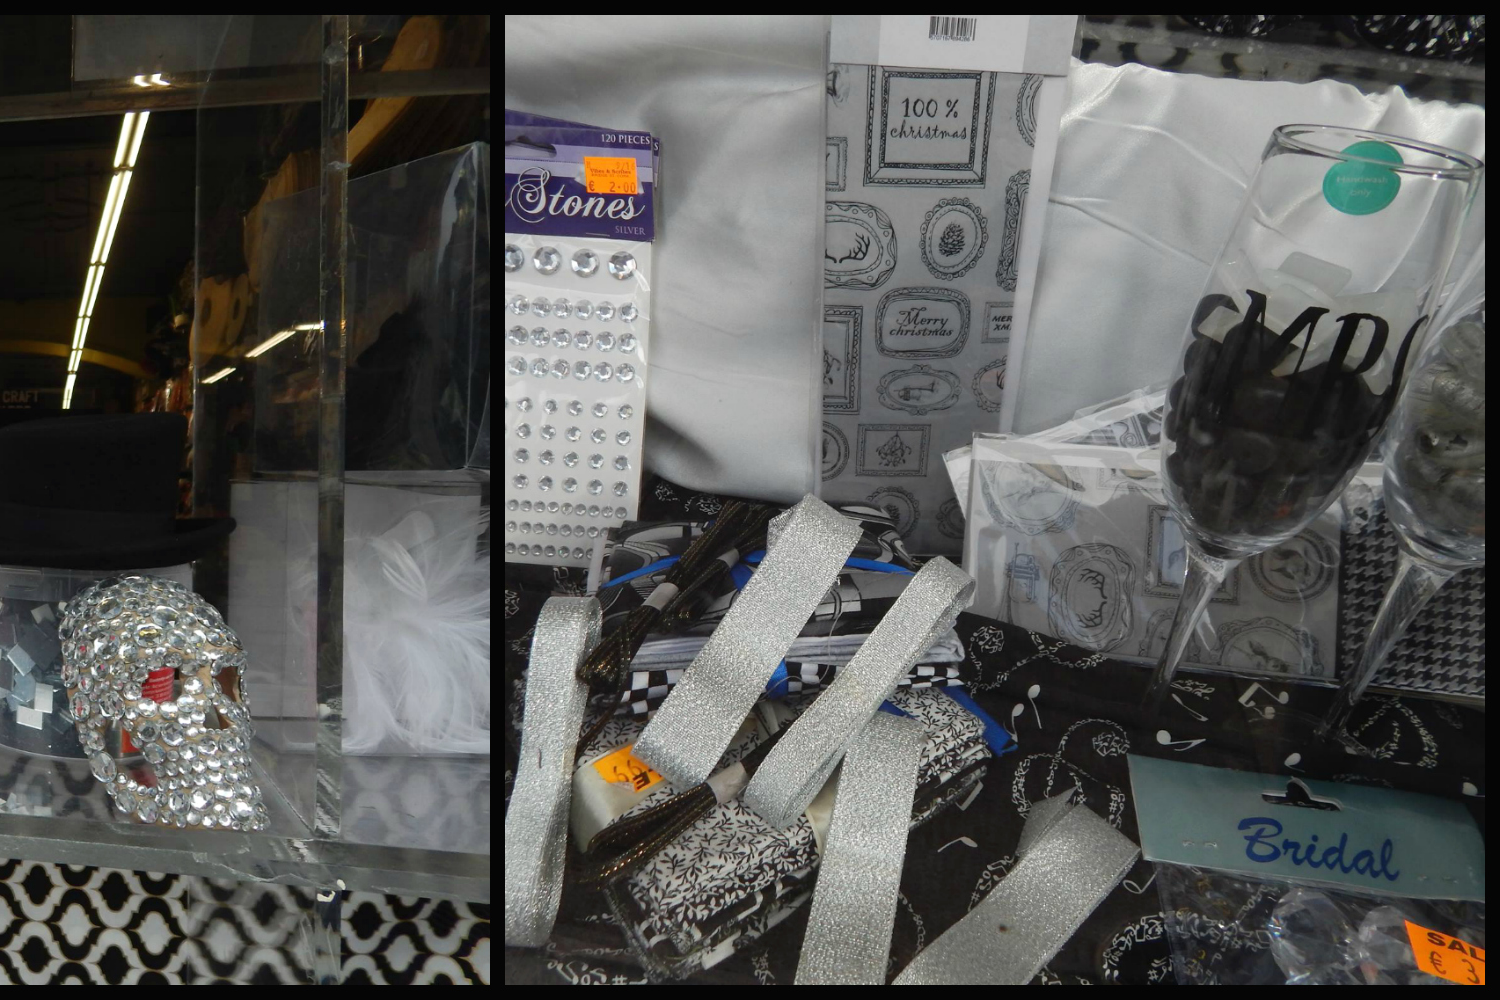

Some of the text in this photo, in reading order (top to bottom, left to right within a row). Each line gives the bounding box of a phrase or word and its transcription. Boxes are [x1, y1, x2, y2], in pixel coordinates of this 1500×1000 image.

[902, 97, 959, 118] 100 %
[601, 134, 650, 145] 120 PIECES
[890, 119, 967, 140] christmas
[505, 166, 646, 224] Stones
[588, 180, 636, 193] € 2.00
[615, 226, 646, 236] SILVER
[895, 306, 949, 329] Merry
[889, 326, 954, 337] christmas
[1238, 816, 1400, 882] Bridal
[1429, 950, 1446, 974] €
